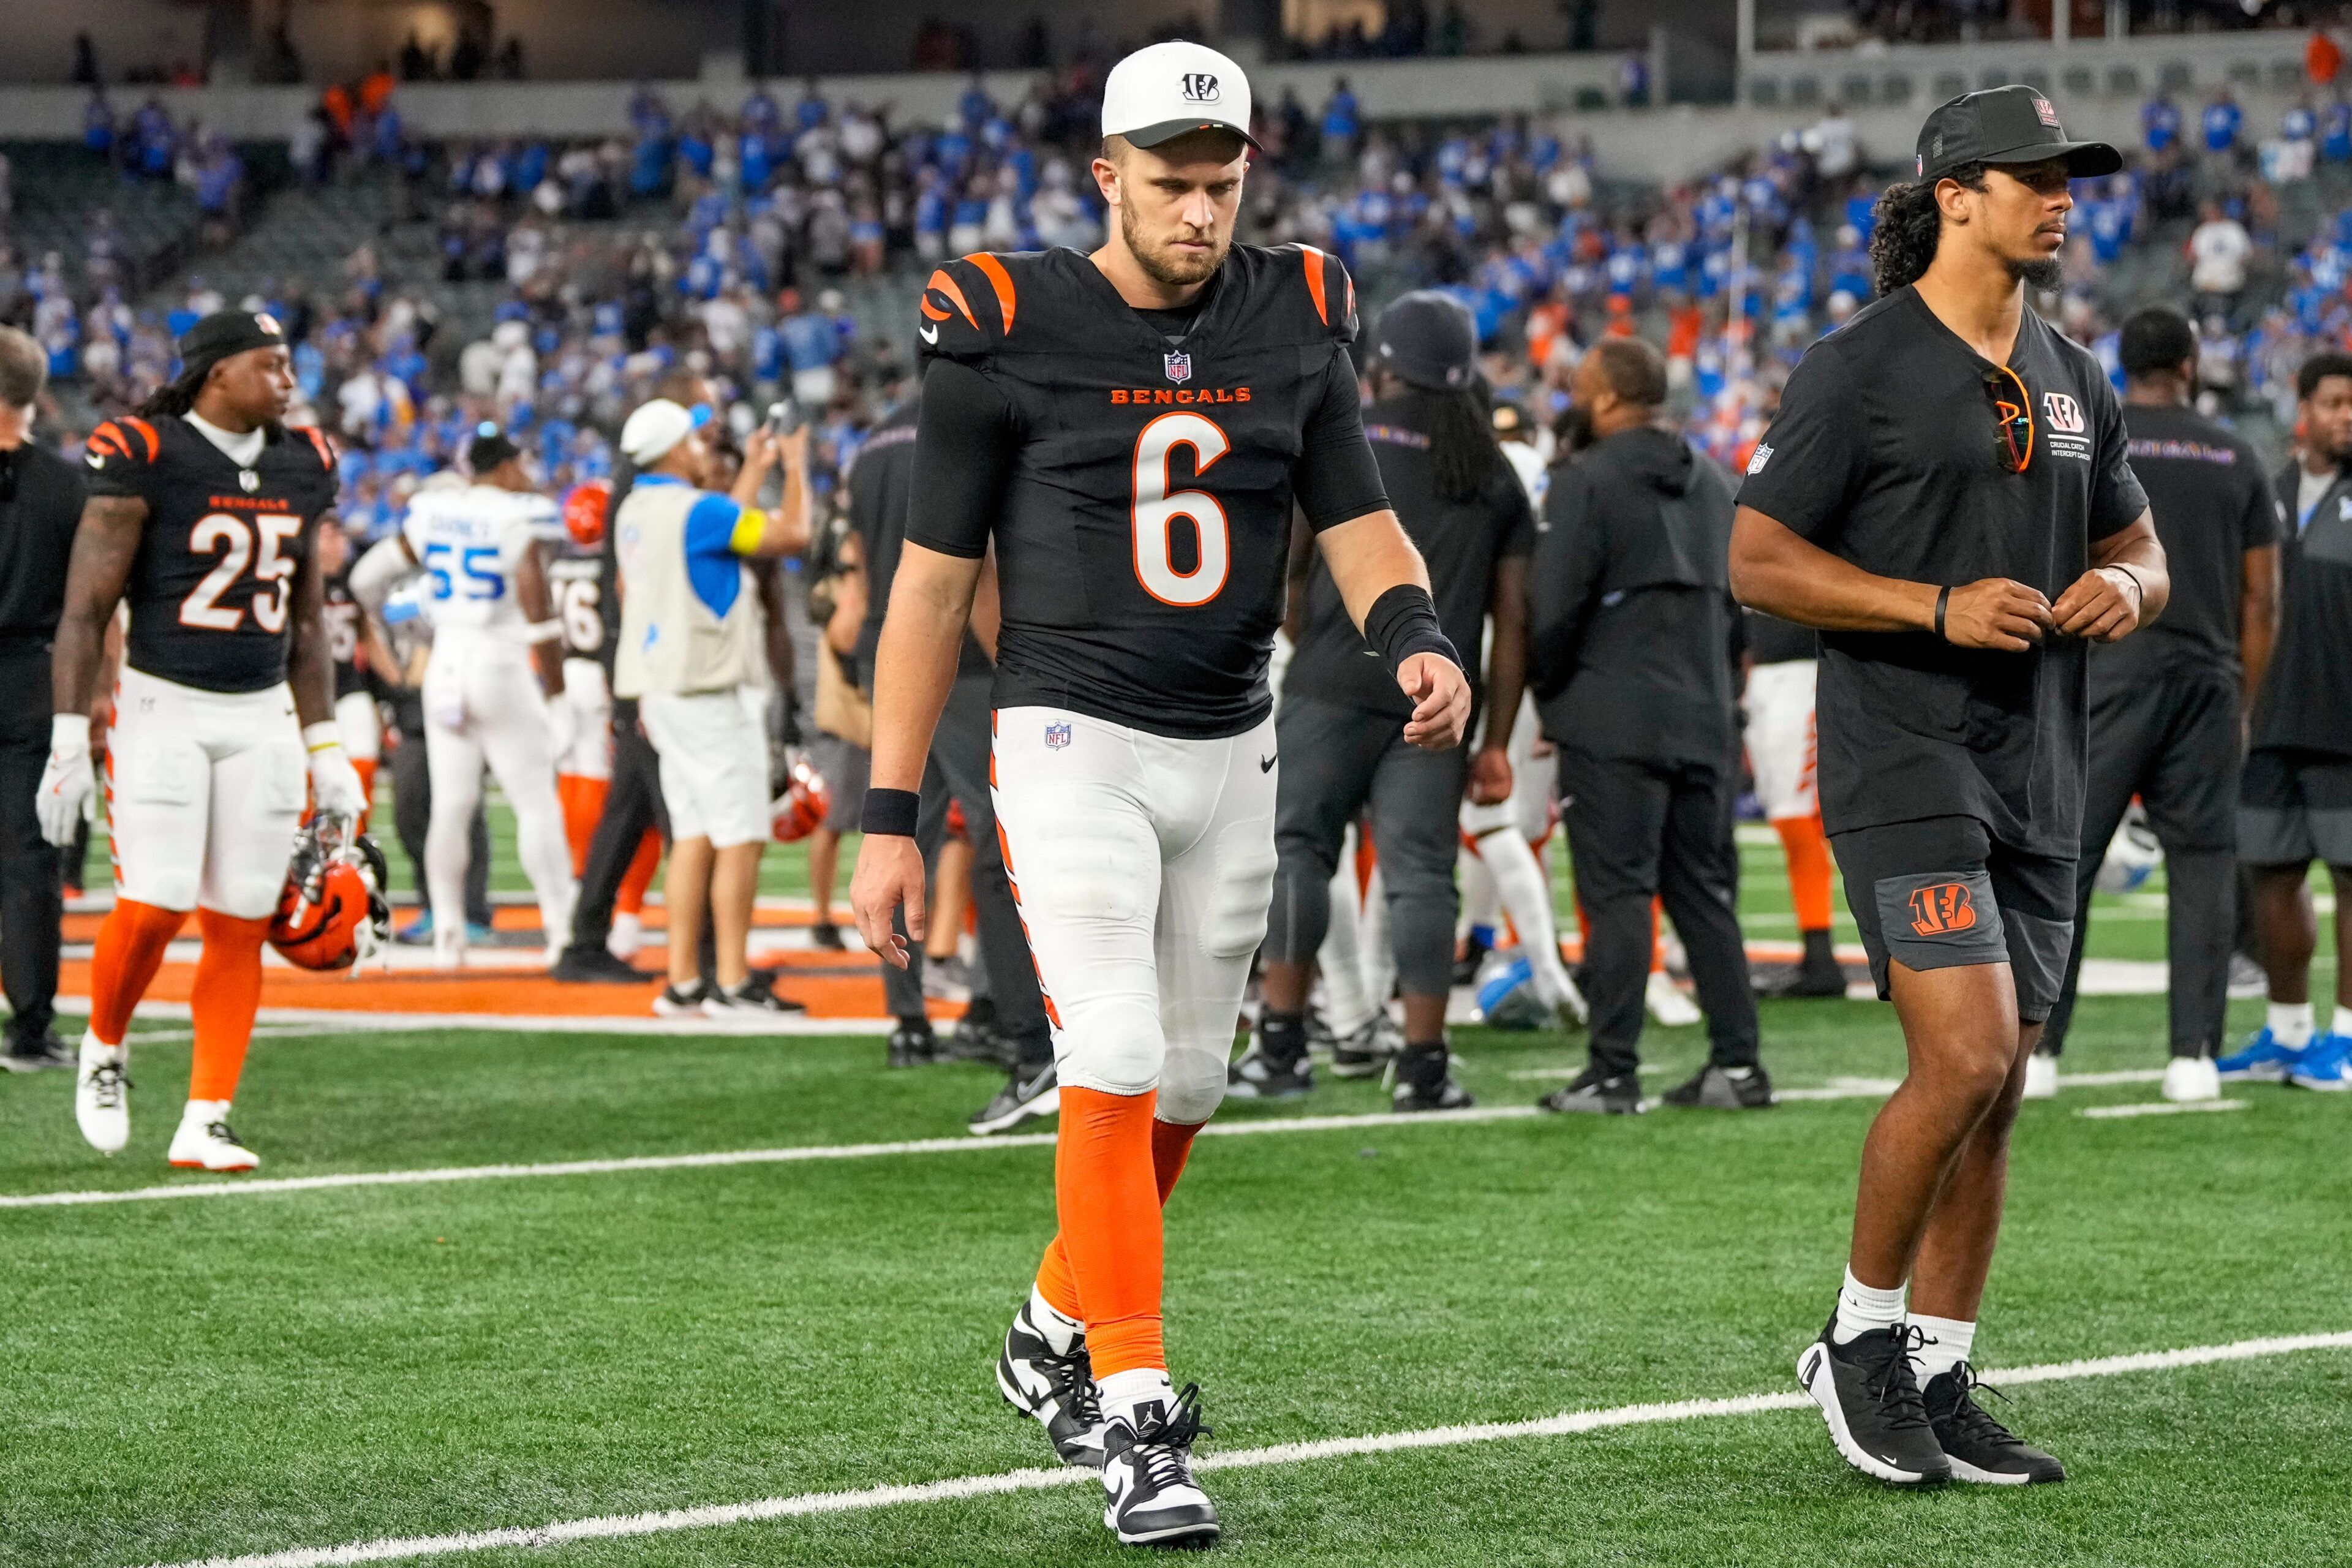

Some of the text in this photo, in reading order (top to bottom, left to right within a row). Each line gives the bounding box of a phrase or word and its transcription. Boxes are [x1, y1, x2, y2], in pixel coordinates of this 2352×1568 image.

[1170, 365, 1187, 378] NFL
[1110, 387, 1251, 404] BENGALS
[2051, 450, 2077, 458] INTERCEPT
[1131, 410, 1231, 607] 6
[179, 513, 303, 633] 25
[424, 542, 507, 600] 55
[1048, 733, 1066, 745] NFL
